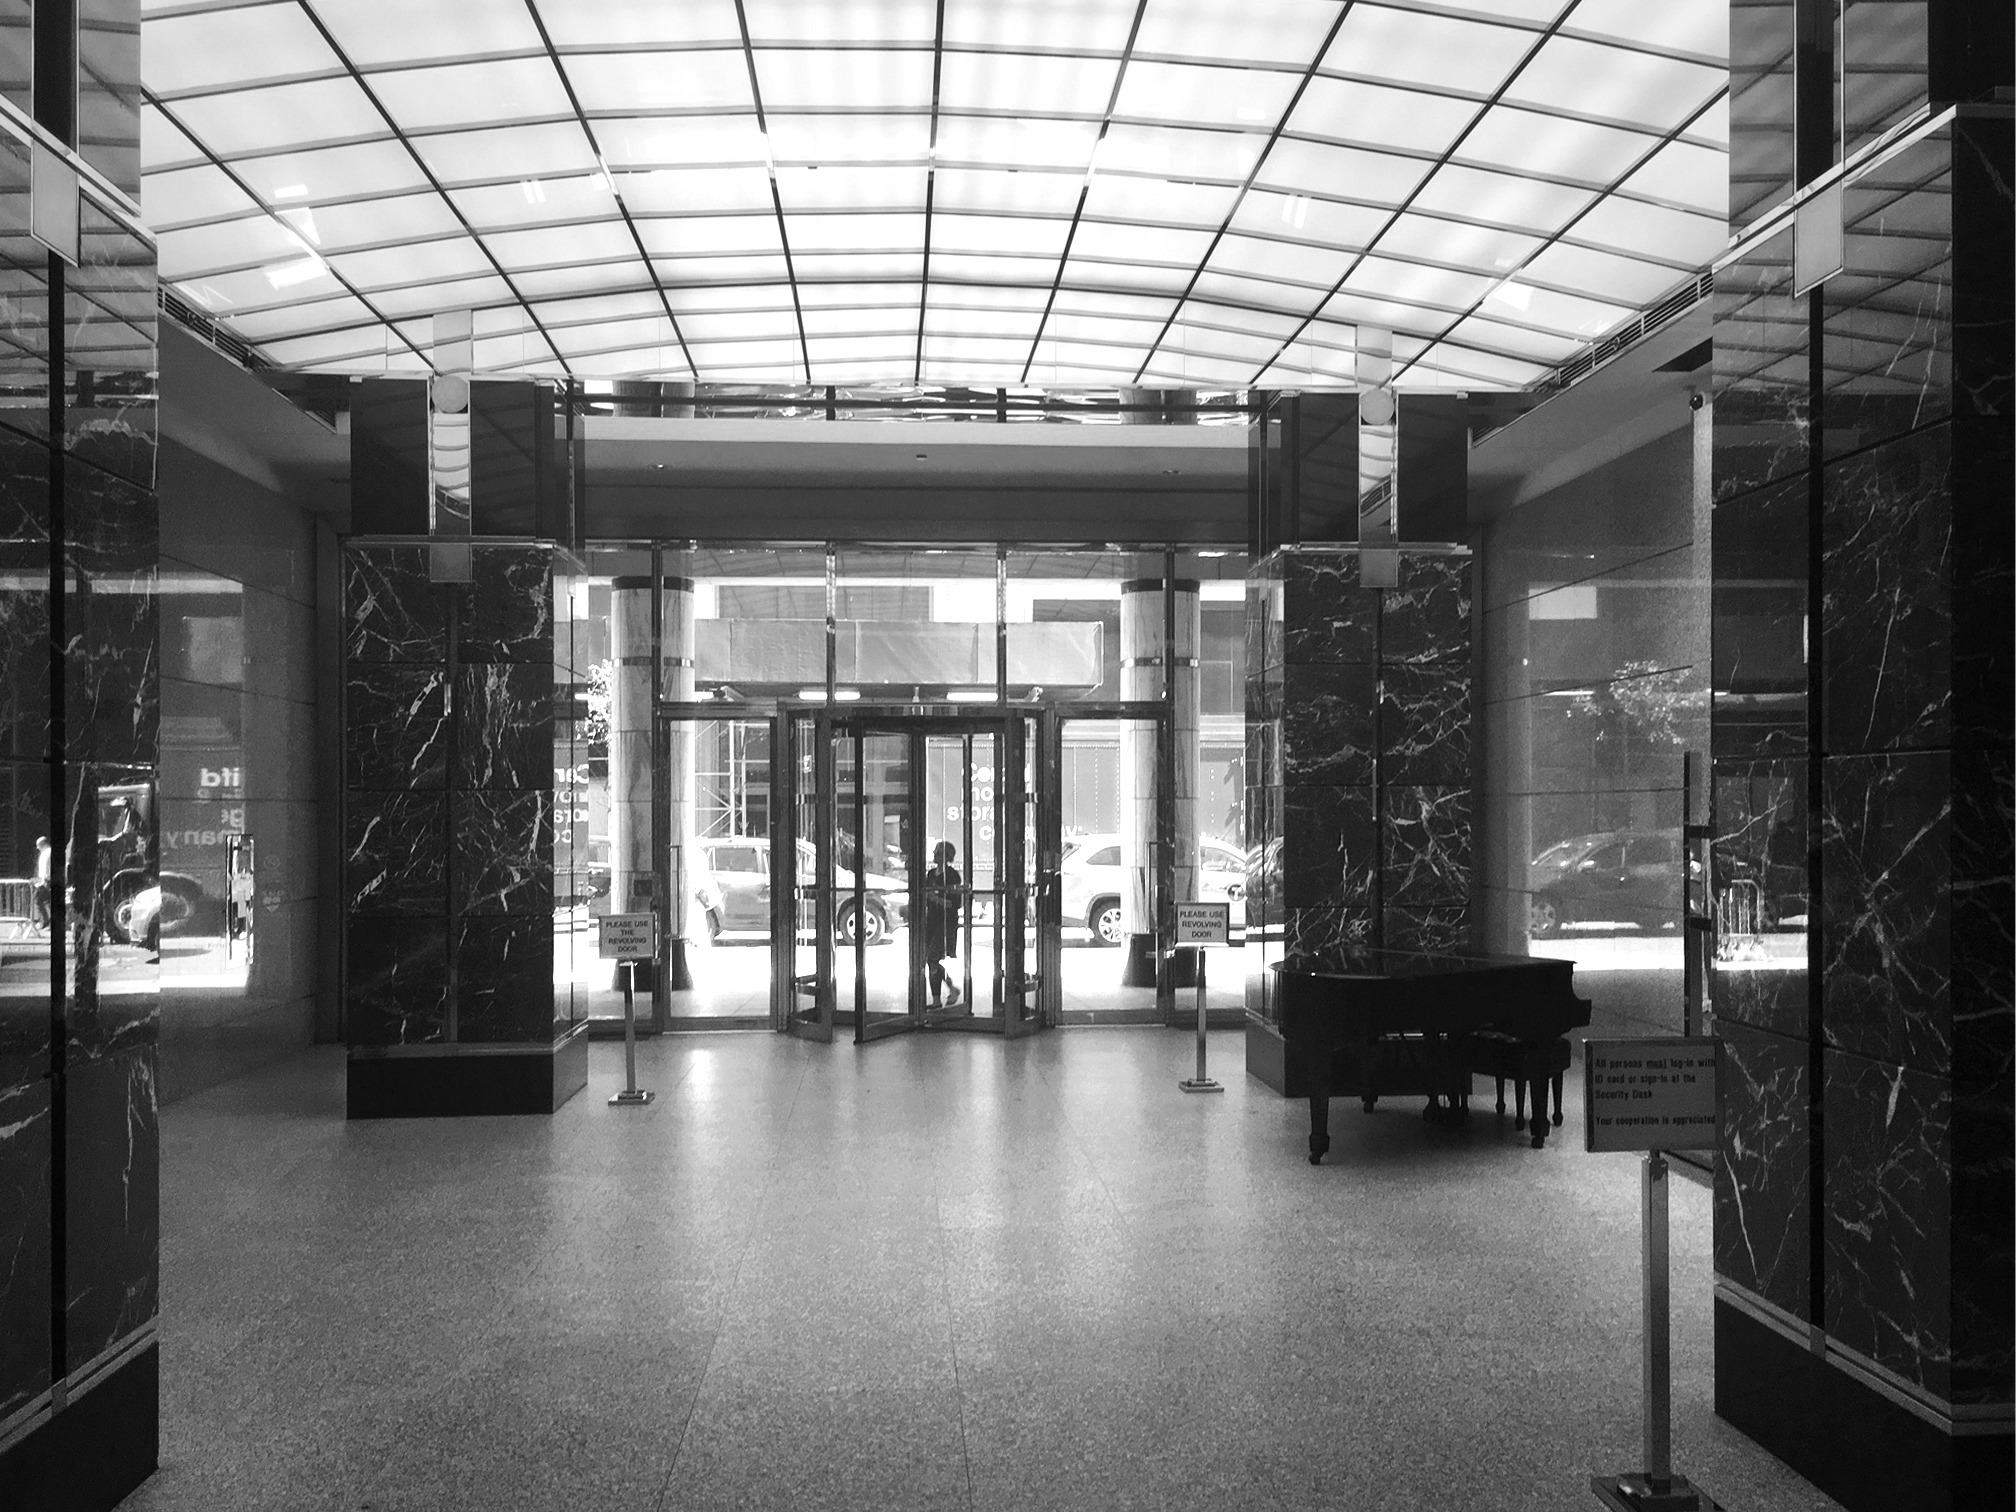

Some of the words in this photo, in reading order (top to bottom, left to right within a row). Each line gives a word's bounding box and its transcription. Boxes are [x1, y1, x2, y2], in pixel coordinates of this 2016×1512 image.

[1180, 910, 1207, 918] PLEASE
[1209, 910, 1225, 918] USE
[605, 920, 632, 928] PLEASE
[634, 920, 648, 928] USE
[1182, 920, 1222, 928] REVOLVING
[1191, 930, 1212, 938] DOOR
[608, 937, 647, 945] REVOLVING
[617, 945, 638, 953] DOOR
[1595, 1058, 1606, 1068] All
[1609, 1060, 1643, 1070] persons
[1646, 1059, 1667, 1069] must
[1670, 1058, 1694, 1069] log-in
[1698, 1058, 1716, 1067] with
[1595, 1074, 1603, 1084] ID
[1607, 1074, 1625, 1084] card
[1628, 1075, 1636, 1084] or
[1640, 1073, 1668, 1085] sign-in
[1671, 1074, 1680, 1083] at
[1683, 1074, 1696, 1083] the
[1595, 1090, 1629, 1101] Security
[1632, 1089, 1653, 1099] Desk
[1596, 1116, 1613, 1125] Your
[1615, 1116, 1659, 1127] cooperation
[1662, 1116, 1669, 1125] is
[1672, 1115, 1716, 1126] appreciated
